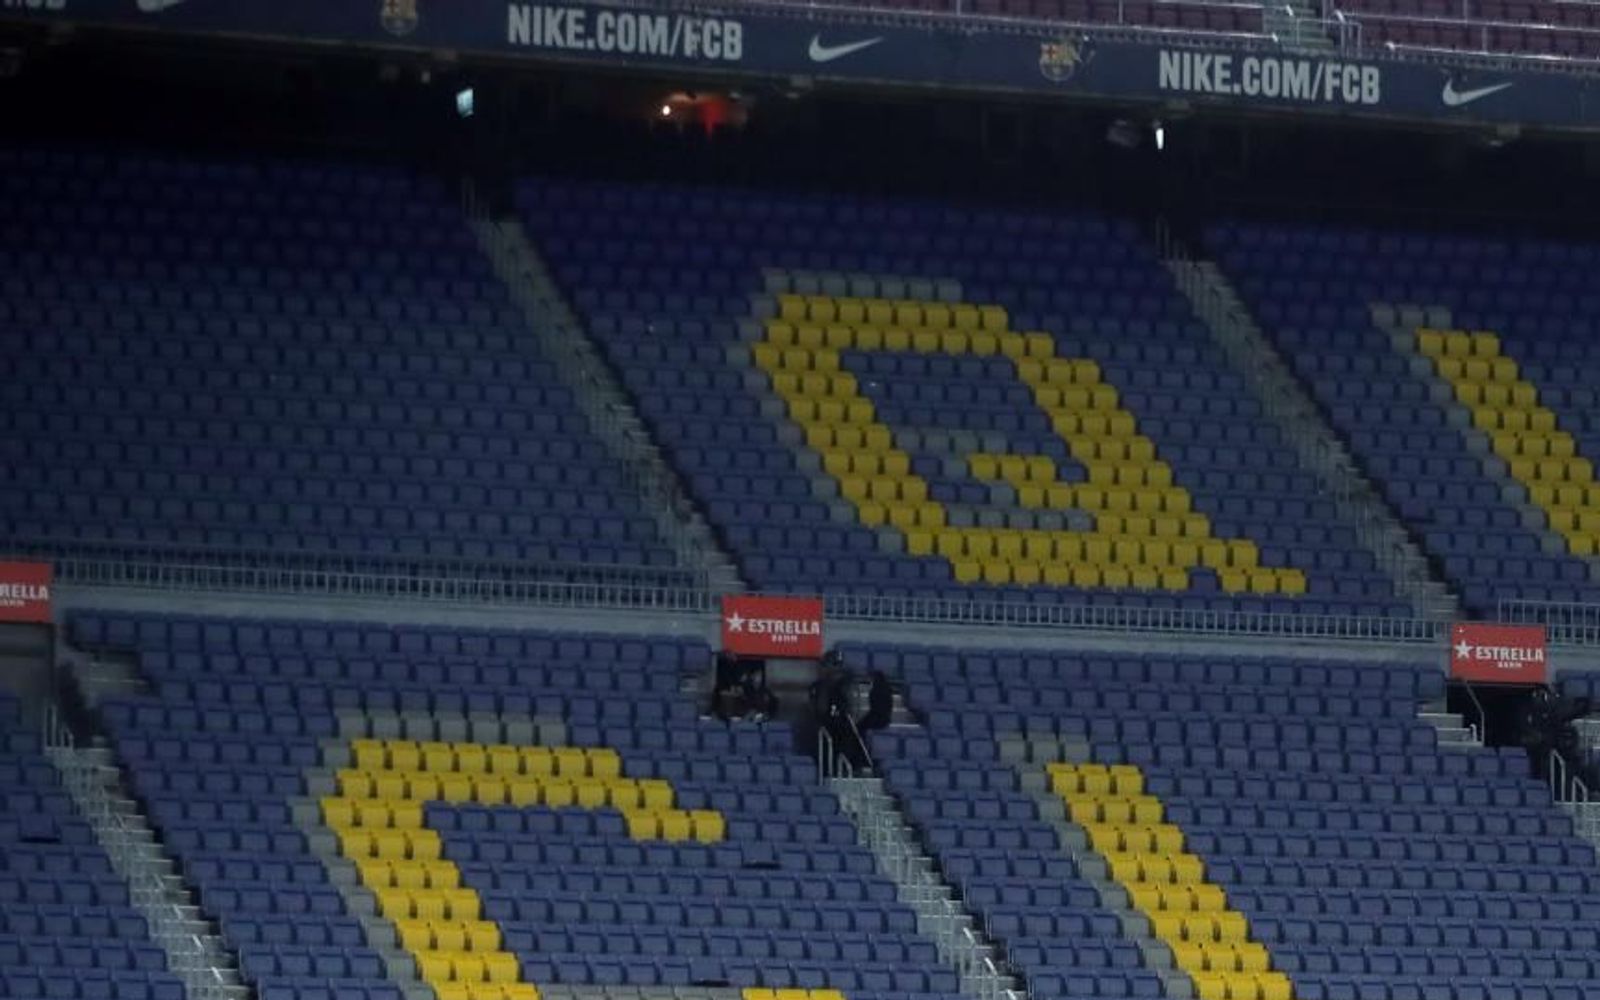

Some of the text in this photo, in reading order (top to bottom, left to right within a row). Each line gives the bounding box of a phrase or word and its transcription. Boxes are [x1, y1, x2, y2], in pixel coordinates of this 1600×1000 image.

[508, 4, 743, 61] NIKE.COM/FCB
[1159, 50, 1380, 104] NIKE.COM/FCB
[748, 619, 820, 635] ESTRELLA
[1475, 645, 1544, 662] ESTRELLA
